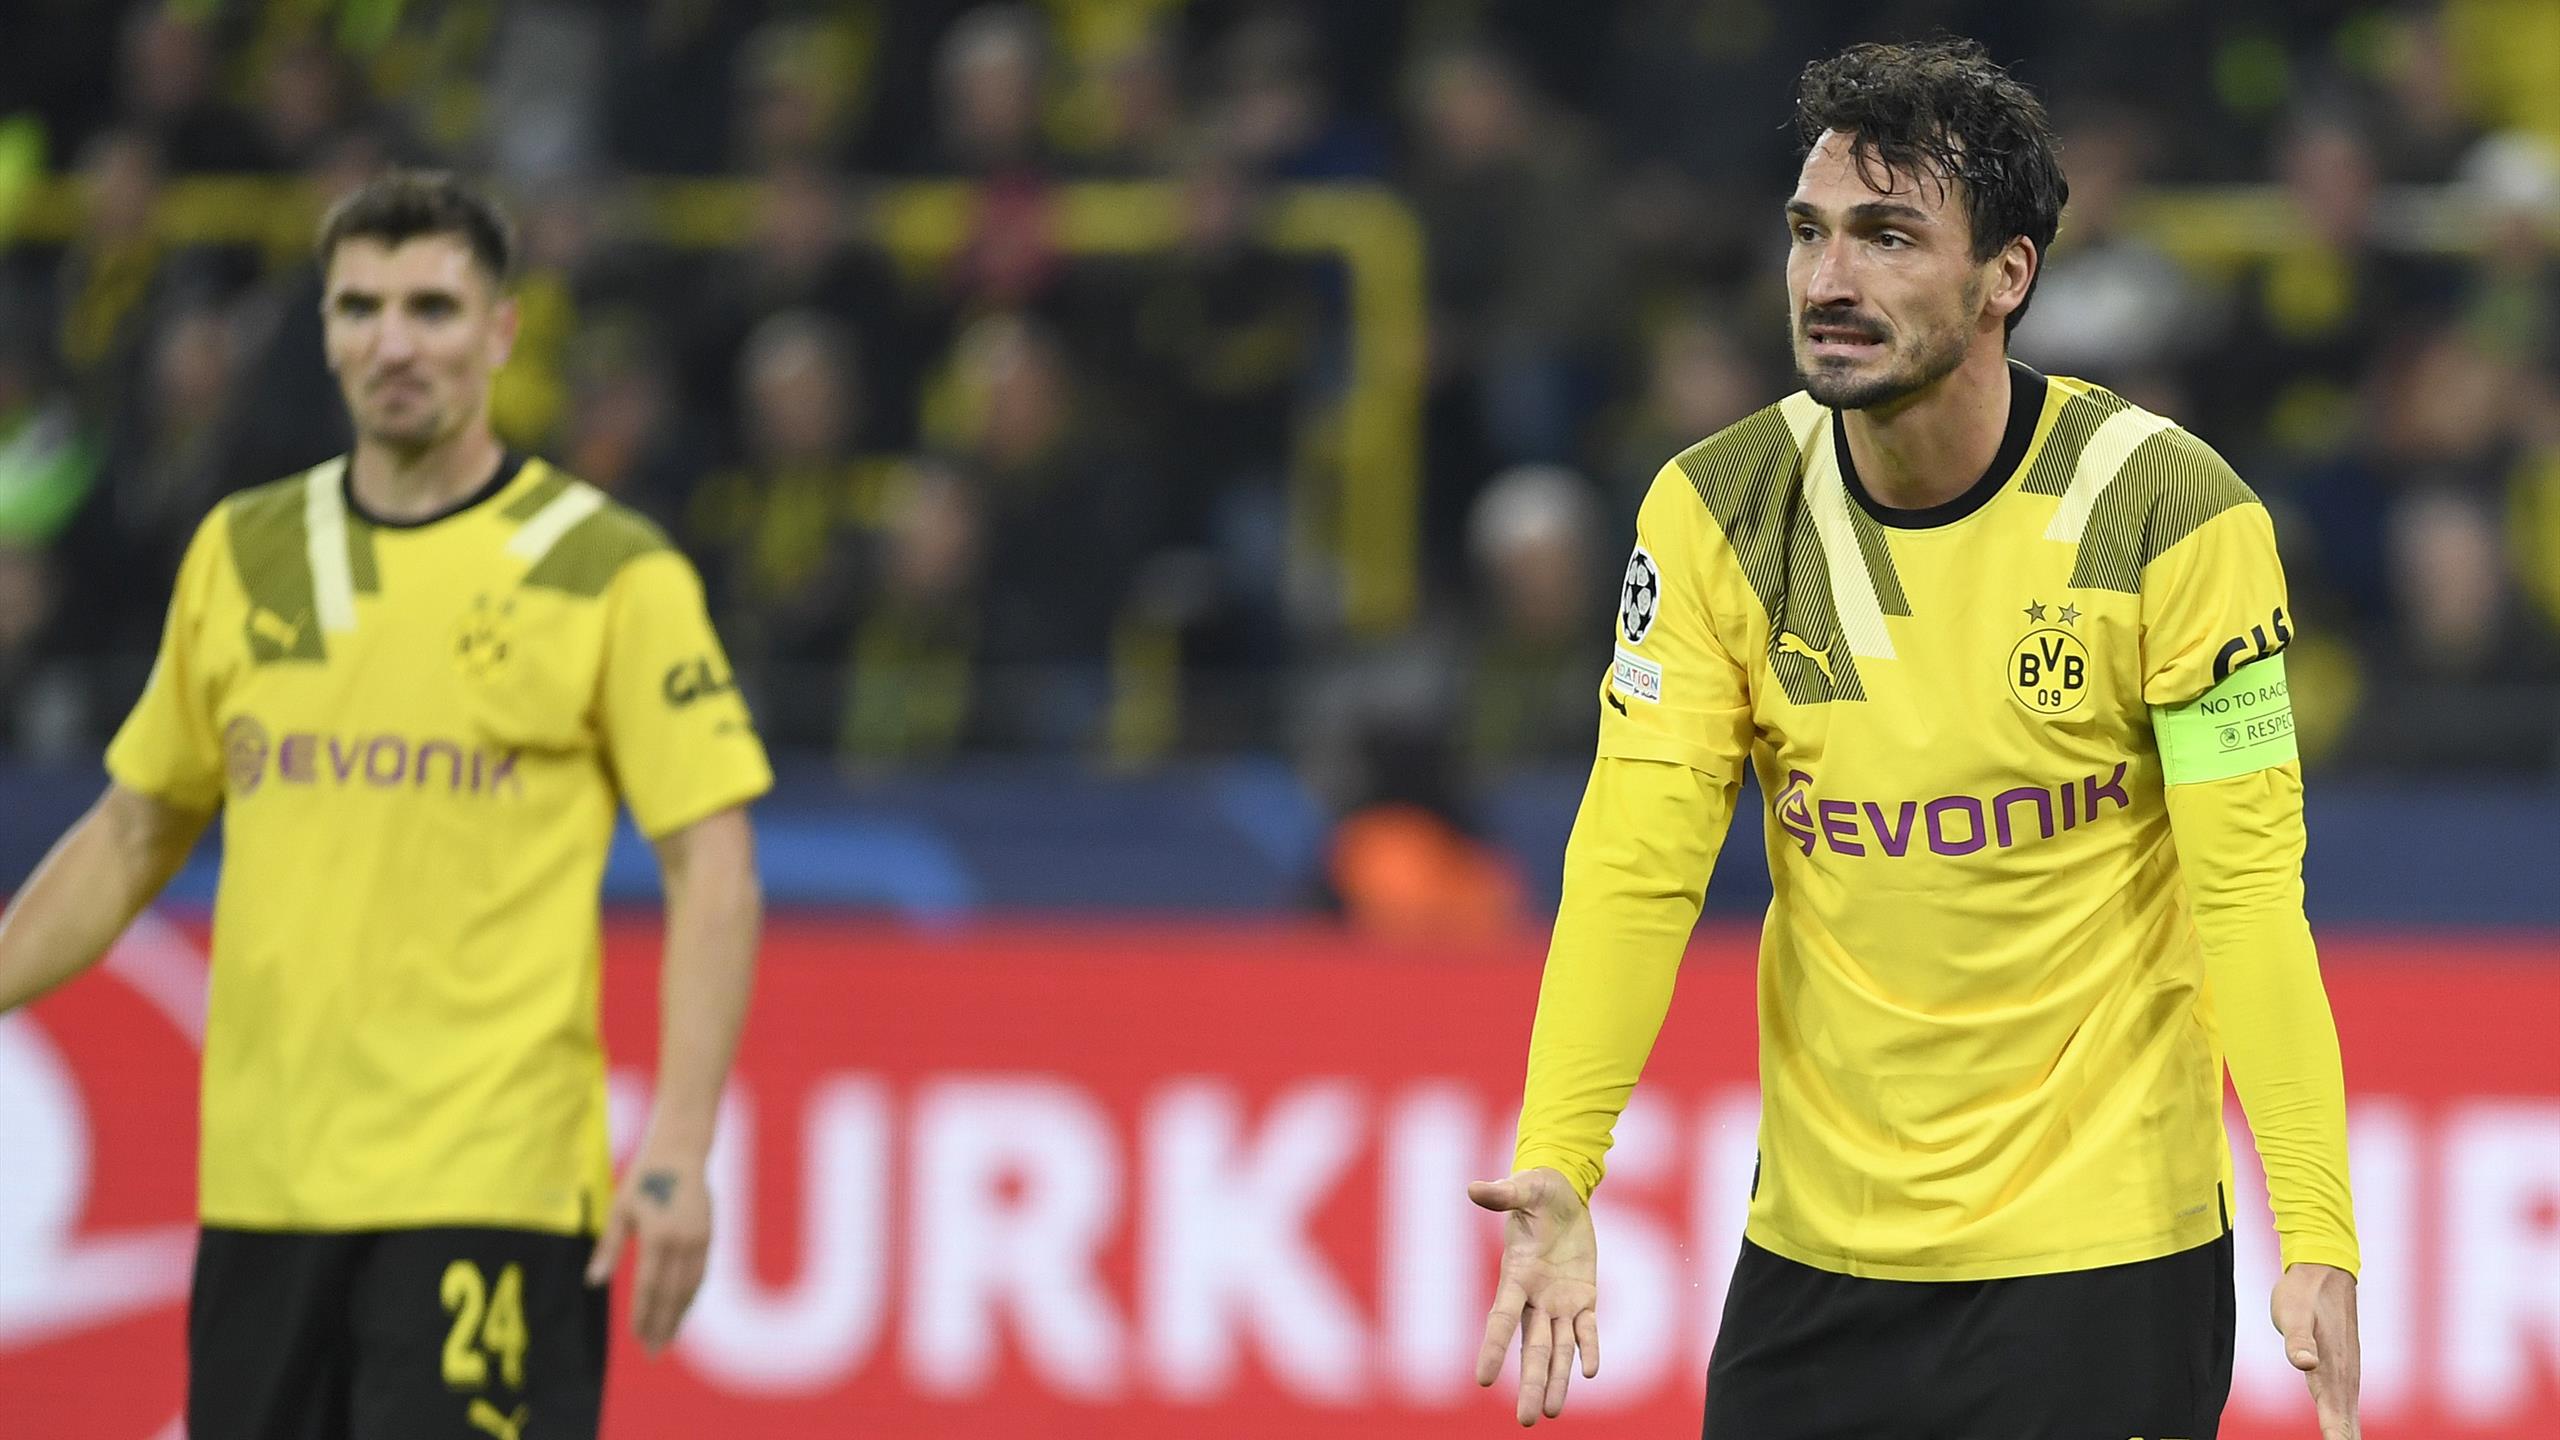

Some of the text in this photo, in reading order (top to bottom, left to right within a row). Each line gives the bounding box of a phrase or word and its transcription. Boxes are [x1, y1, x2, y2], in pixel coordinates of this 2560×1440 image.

[661, 655, 738, 708] GL
[2019, 637, 2084, 689] BVB
[2037, 688, 2062, 706] 09
[2200, 697, 2230, 716] NO
[2232, 691, 2256, 709] TO
[2246, 711, 2293, 740] RESPEC
[279, 733, 524, 799] EVONIK
[1818, 761, 2130, 857] EVONIK
[606, 1072, 1760, 1403] URKIS
[440, 1258, 529, 1389] 24
